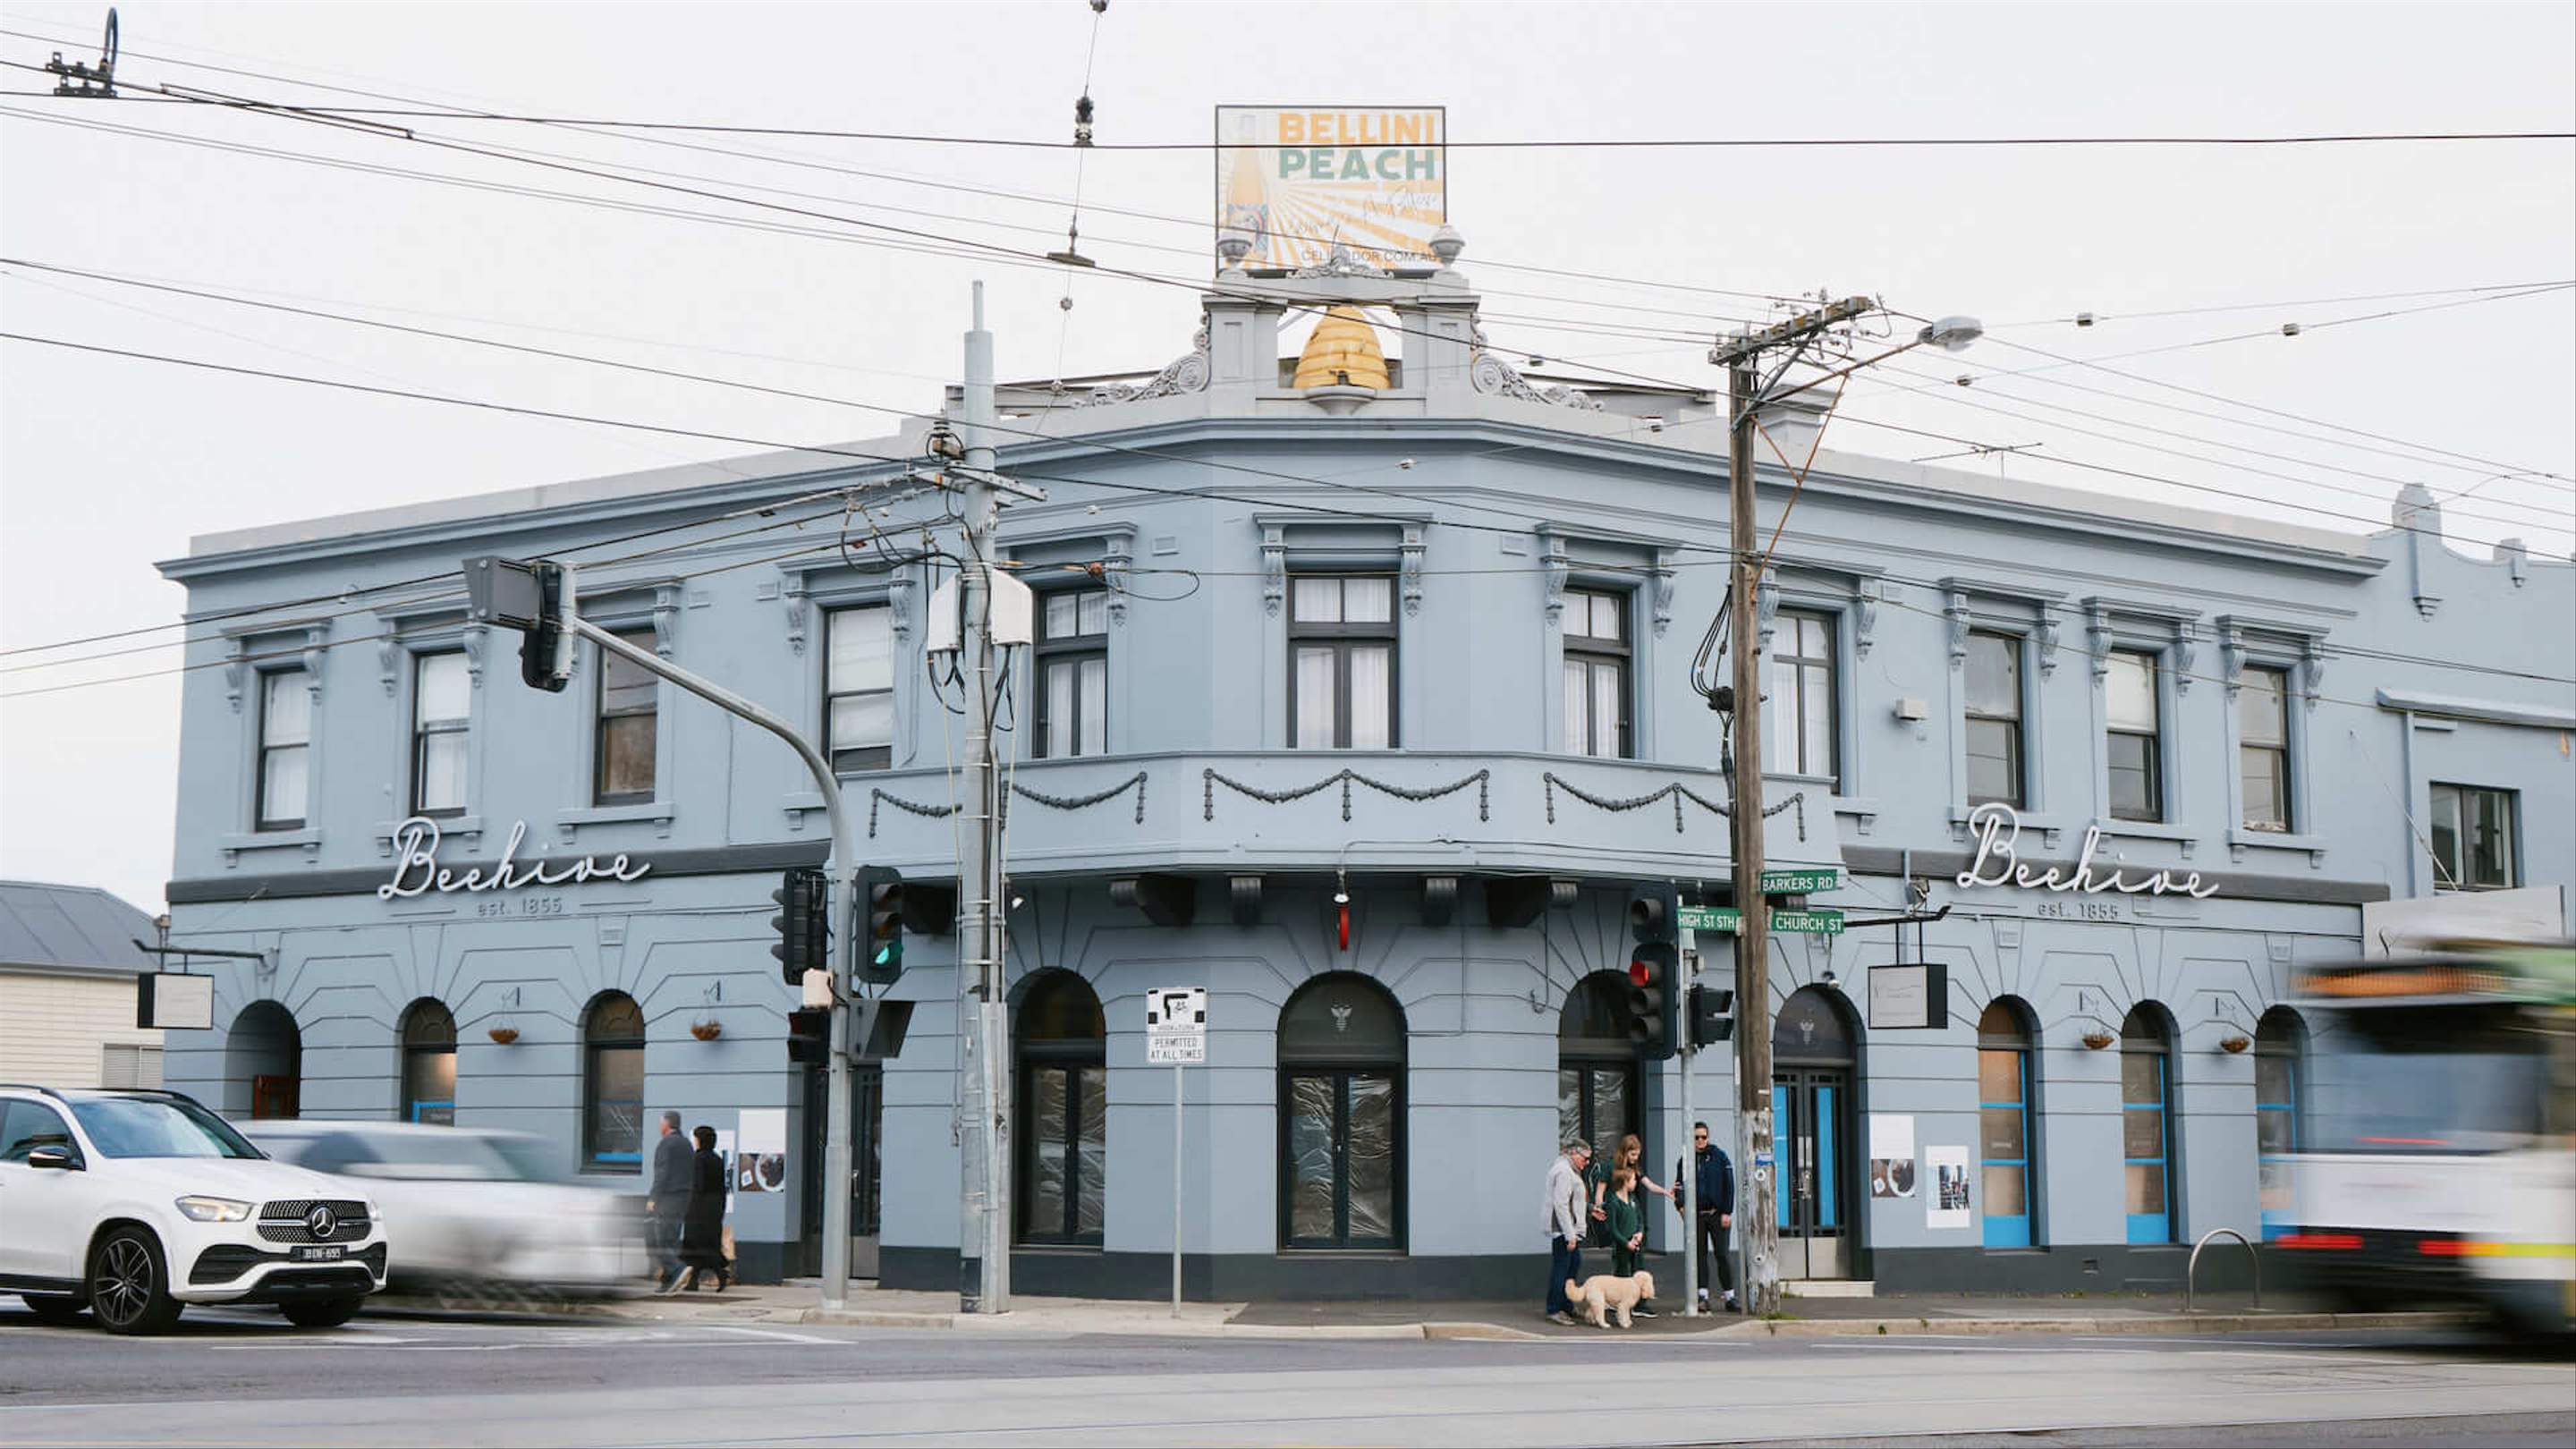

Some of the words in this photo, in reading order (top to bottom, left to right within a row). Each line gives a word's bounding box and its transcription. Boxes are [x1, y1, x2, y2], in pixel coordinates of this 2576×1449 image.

[1278, 113, 1435, 145] BELLINI
[1278, 148, 1435, 180] PEACH
[377, 816, 653, 901] Beehive
[1956, 802, 2220, 899] Beehive
[1762, 877, 1815, 892] BARKERS
[1817, 876, 1834, 890] RD
[521, 896, 563, 914] 1855
[2080, 902, 2119, 919] 1855
[1678, 913, 1701, 928] HIGH
[1703, 914, 1715, 928] ST
[1716, 915, 1735, 928] STH
[1775, 916, 1825, 931] CHURCH
[1828, 918, 1843, 931] ST
[1155, 1038, 1197, 1048] PERMITTED
